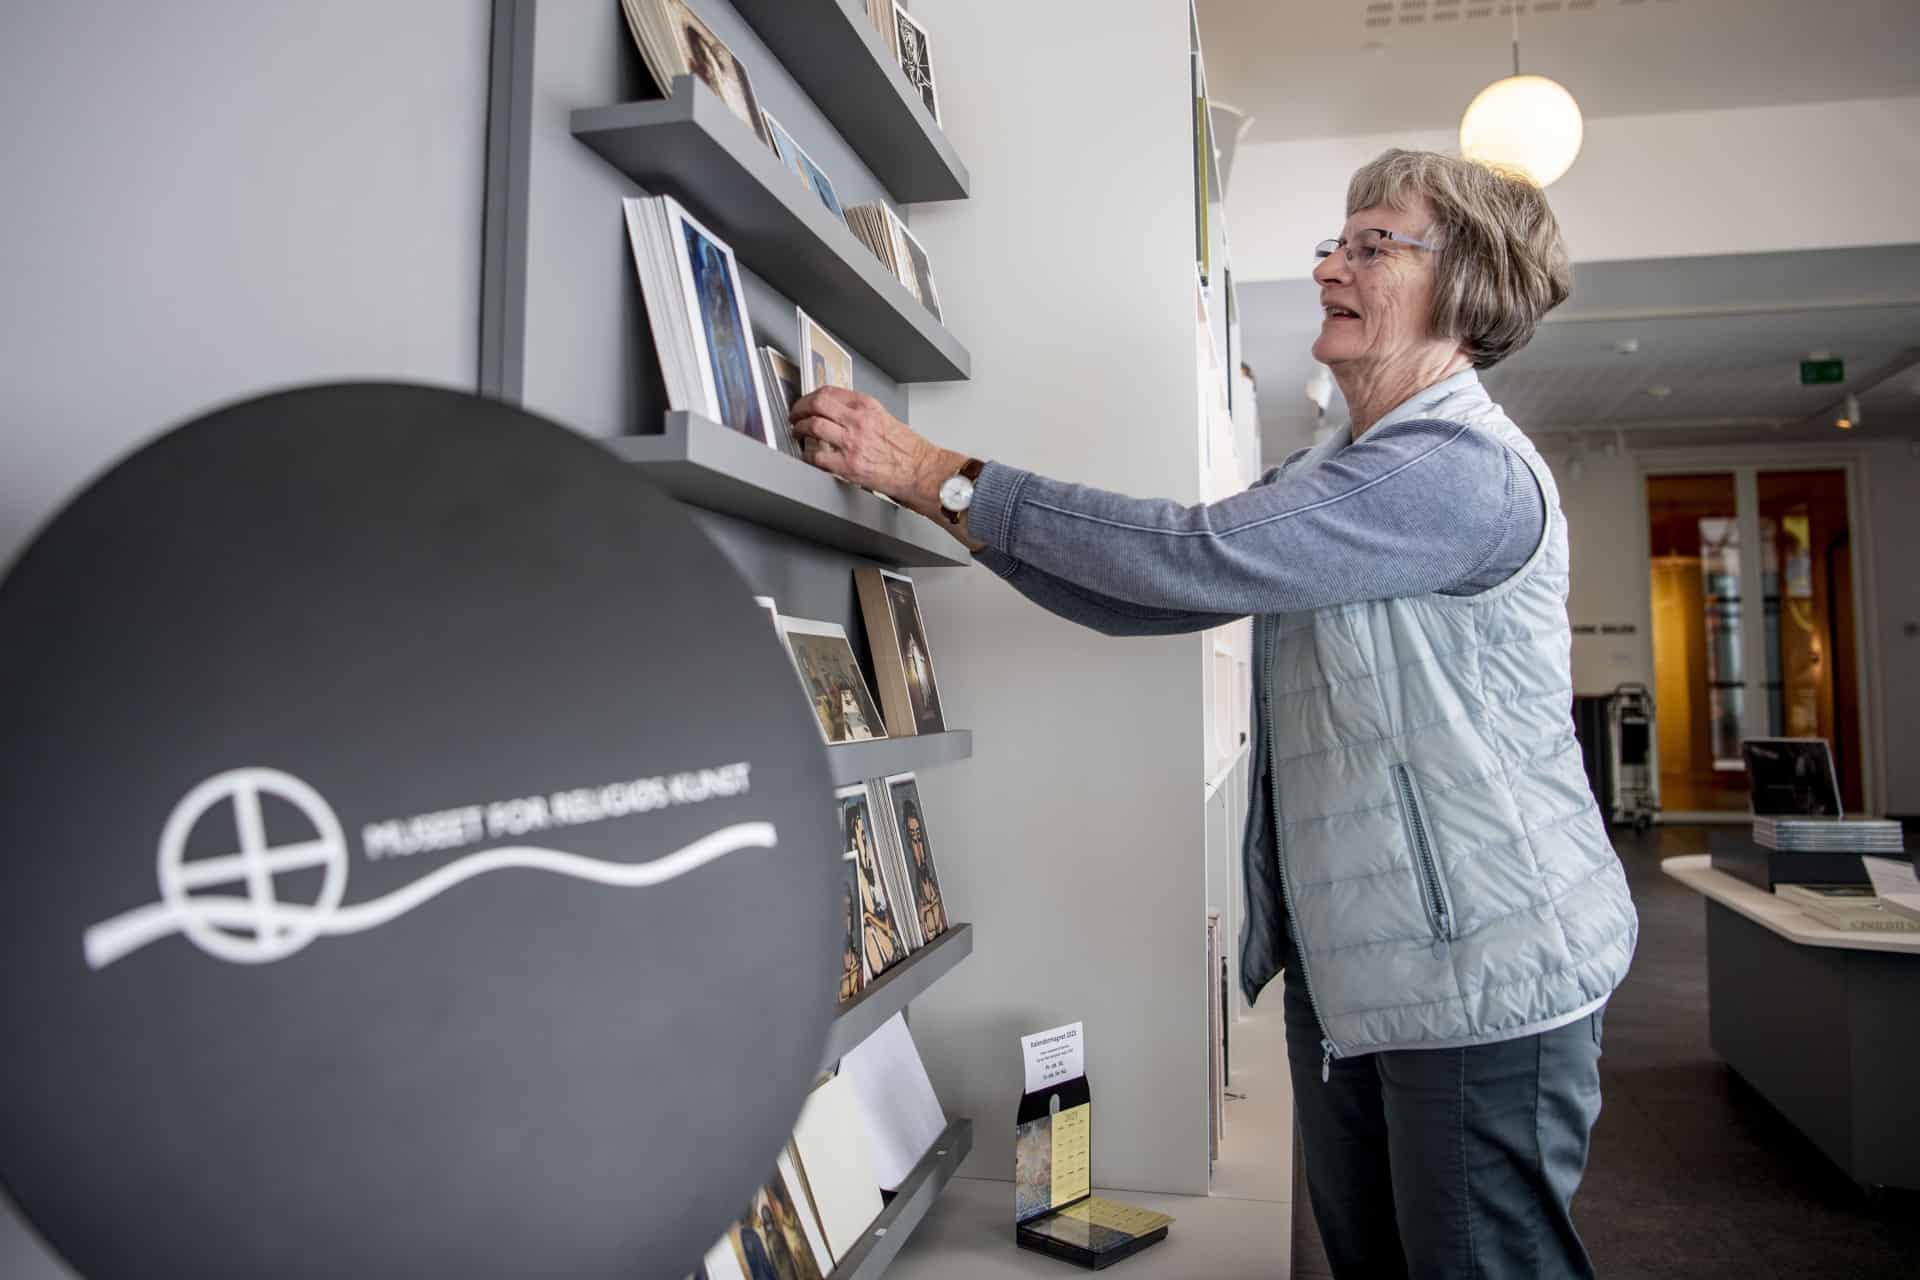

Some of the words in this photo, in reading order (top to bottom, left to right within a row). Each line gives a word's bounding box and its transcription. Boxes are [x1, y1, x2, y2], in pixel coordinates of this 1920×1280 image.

[363, 804, 484, 860] MUSEET
[486, 796, 548, 838] FOR
[669, 762, 751, 804] KUNST
